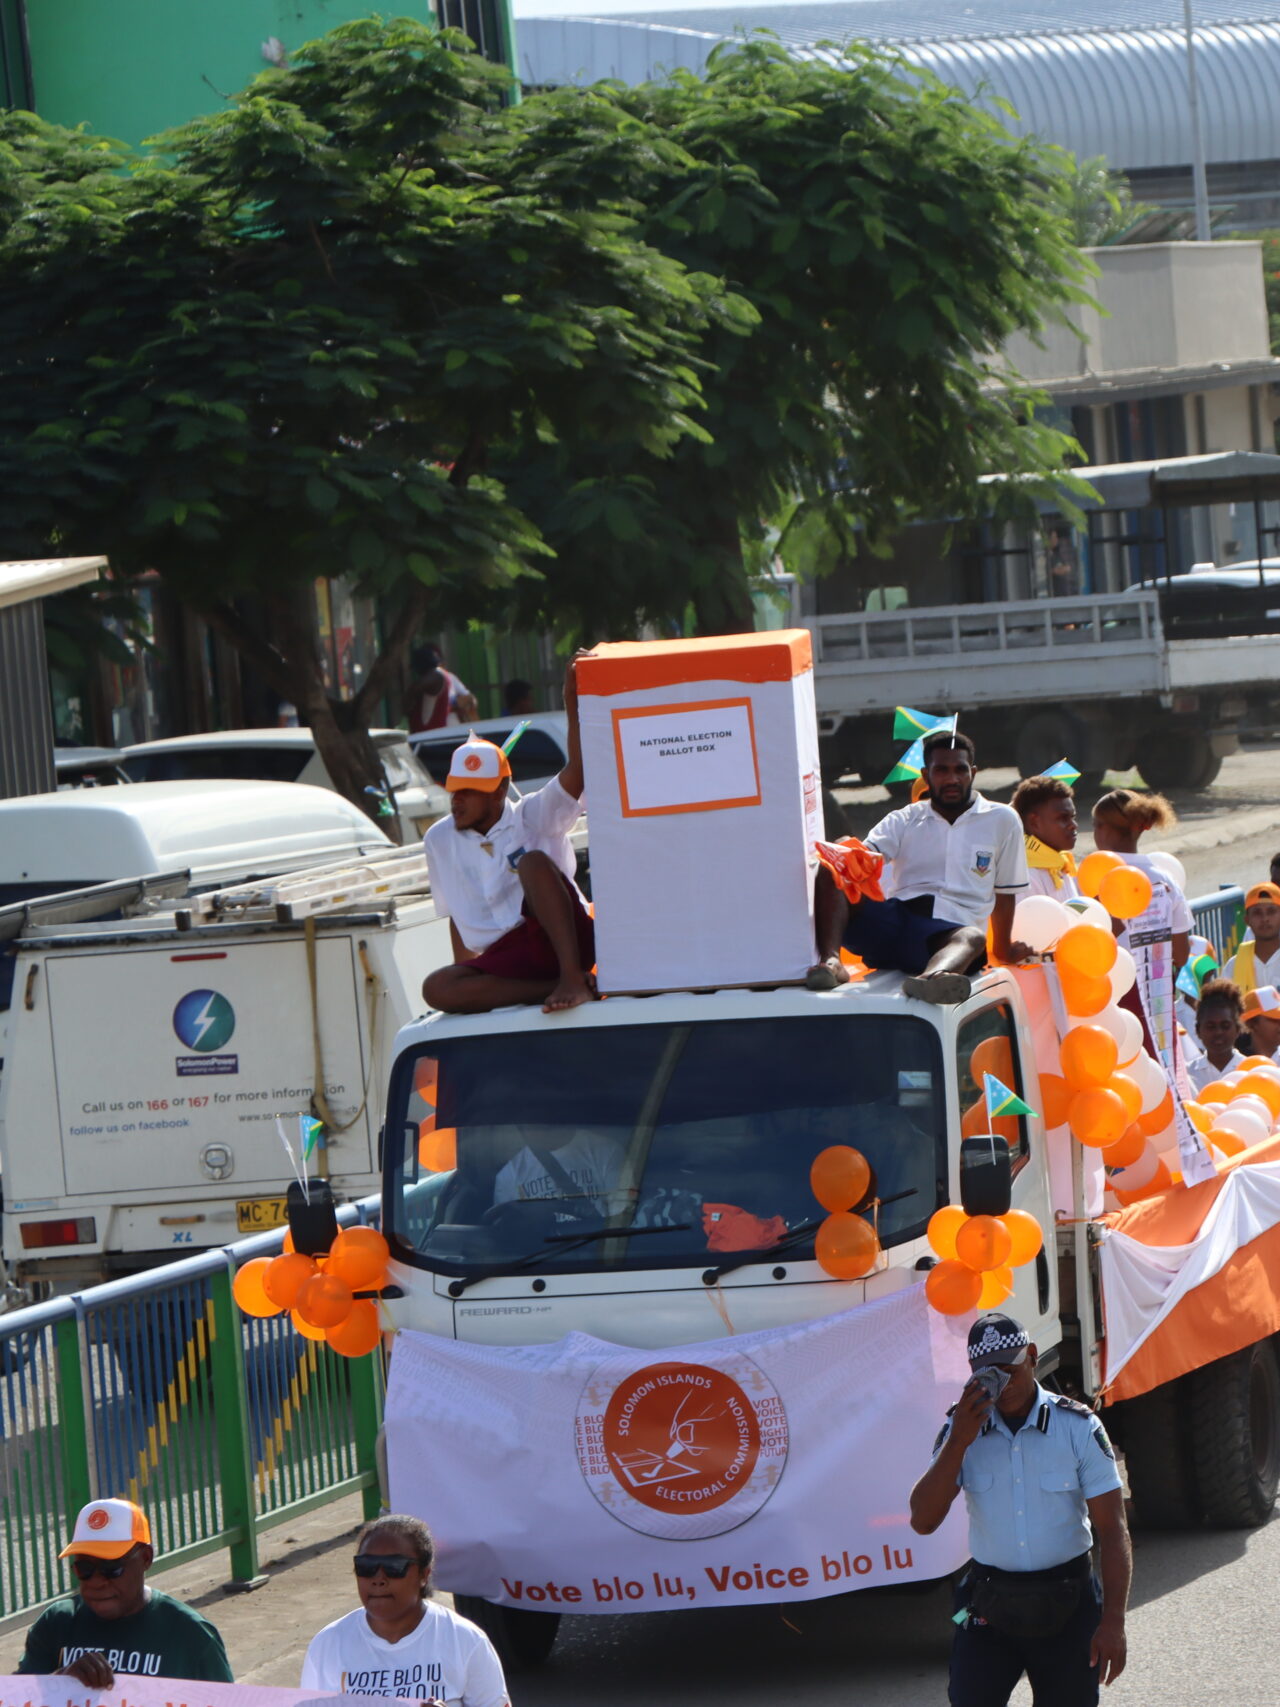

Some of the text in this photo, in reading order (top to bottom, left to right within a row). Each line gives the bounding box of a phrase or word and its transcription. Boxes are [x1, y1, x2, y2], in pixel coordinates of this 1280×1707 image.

[640, 730, 732, 747] NATIONAL ELECTION
[659, 744, 716, 757] BALLOT BOX
[82, 1101, 106, 1114] Call
[109, 1102, 124, 1112] us
[128, 1101, 143, 1110] on
[146, 1099, 168, 1111] 166
[172, 1097, 185, 1107] or
[188, 1096, 209, 1108] 167
[214, 1092, 231, 1103] for
[235, 1090, 268, 1101] more
[69, 1117, 190, 1136] follow us on facebook
[522, 1175, 553, 1198] VOTE
[172, 1231, 193, 1243] XL
[618, 1374, 713, 1437] SOLOMON ISLANDS
[655, 1397, 749, 1502] ELECTORAL COMMISSION
[501, 1577, 583, 1603] Vote
[593, 1576, 644, 1602] blo
[705, 1563, 810, 1593] Voice
[820, 1552, 872, 1582] blo
[107, 1649, 140, 1673] BLO
[348, 1662, 442, 1689] VOTE BLO IU
